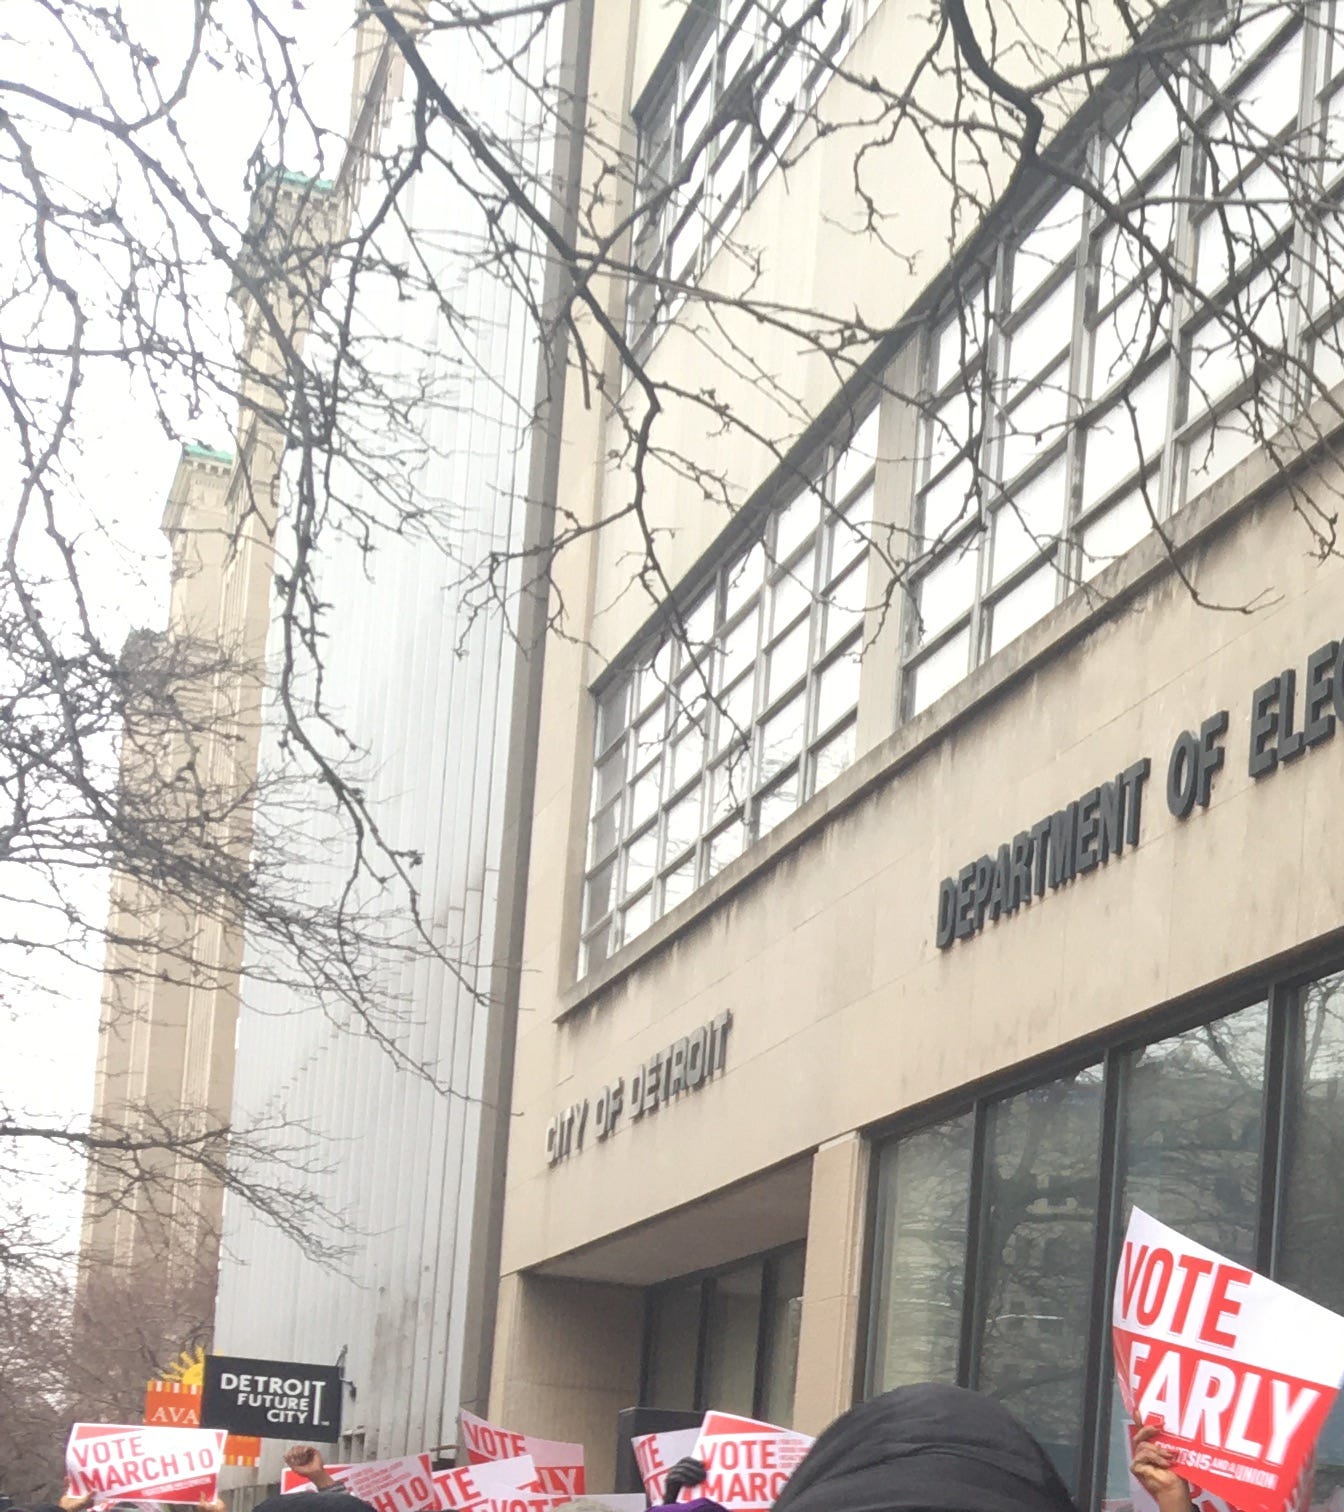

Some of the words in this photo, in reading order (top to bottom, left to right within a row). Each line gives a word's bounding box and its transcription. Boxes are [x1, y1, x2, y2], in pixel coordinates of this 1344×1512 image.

[935, 757, 1151, 949] DEPARTMENT
[1167, 710, 1229, 818] OF
[545, 1098, 589, 1165] CITY
[596, 1076, 624, 1139] OF
[629, 1008, 733, 1120] DETROIT
[1121, 1241, 1254, 1350] VOTE
[237, 1393, 309, 1411] FUTURE
[267, 1409, 308, 1425] CITY
[1129, 1342, 1321, 1466] EARLY
[72, 1436, 144, 1467] VOTE
[464, 1421, 526, 1458] VOTE
[700, 1440, 777, 1470] VOTE
[79, 1454, 179, 1493] MARCH
[183, 1448, 214, 1471] 10
[433, 1467, 481, 1508] TE
[701, 1472, 790, 1502] MARC
